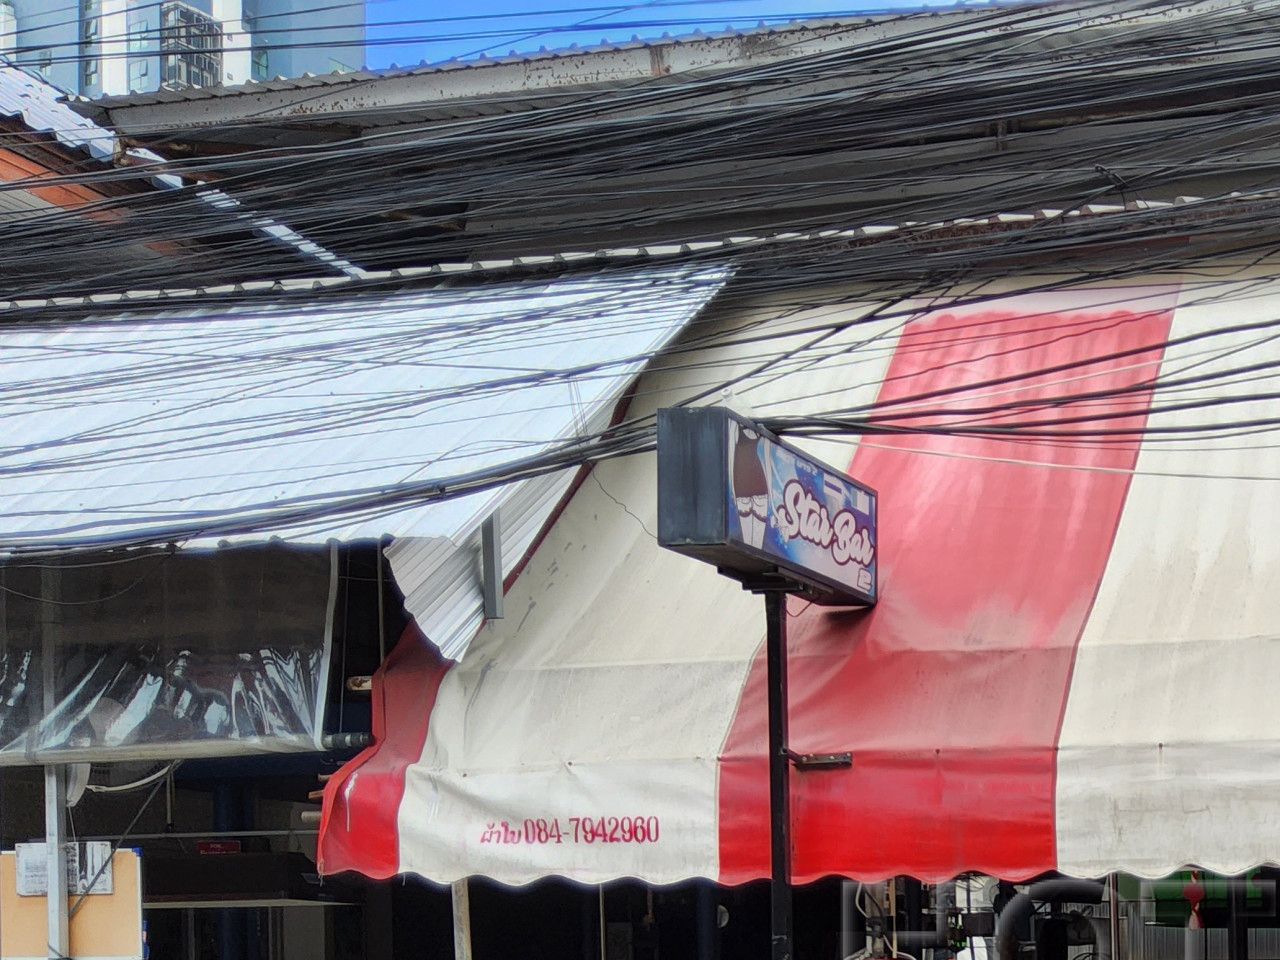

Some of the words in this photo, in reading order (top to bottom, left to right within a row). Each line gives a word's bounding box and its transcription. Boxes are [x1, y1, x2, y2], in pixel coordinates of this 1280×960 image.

[775, 479, 833, 549] Star
[831, 507, 875, 566] Bar
[524, 816, 660, 844] 084-7942960
